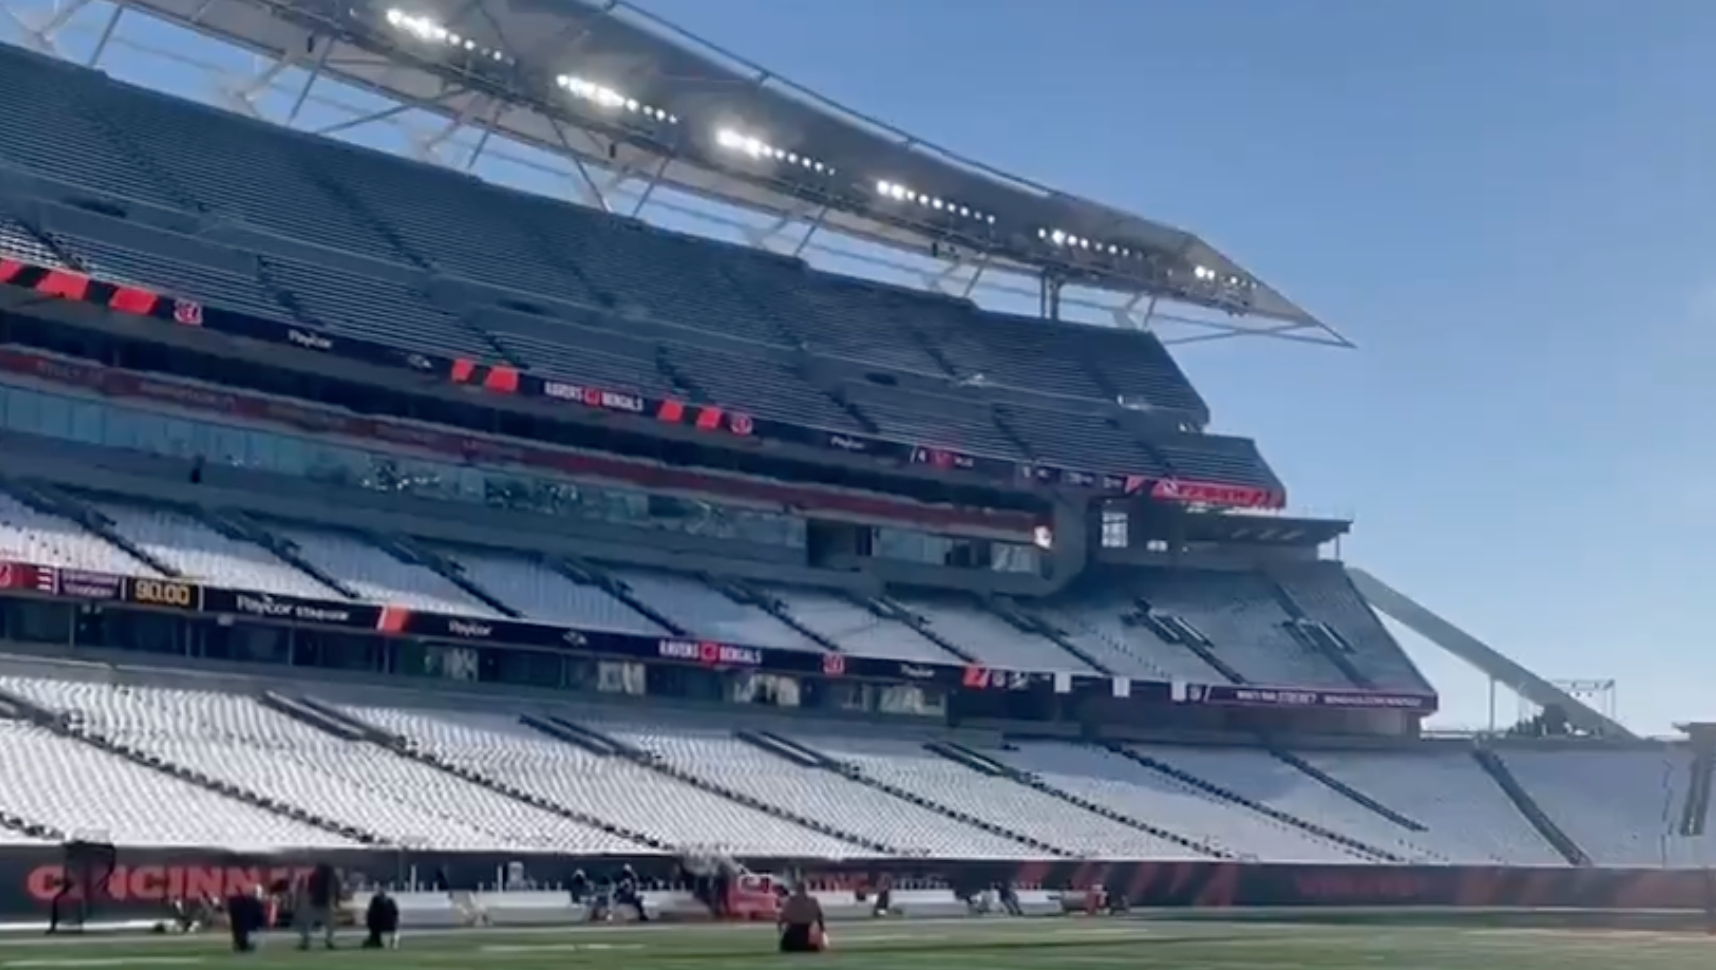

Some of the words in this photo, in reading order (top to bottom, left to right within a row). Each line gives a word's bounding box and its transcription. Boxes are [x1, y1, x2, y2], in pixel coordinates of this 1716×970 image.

[236, 594, 293, 615] Paycor
[659, 640, 699, 660] RAVENS
[719, 645, 763, 664] BENGALS
